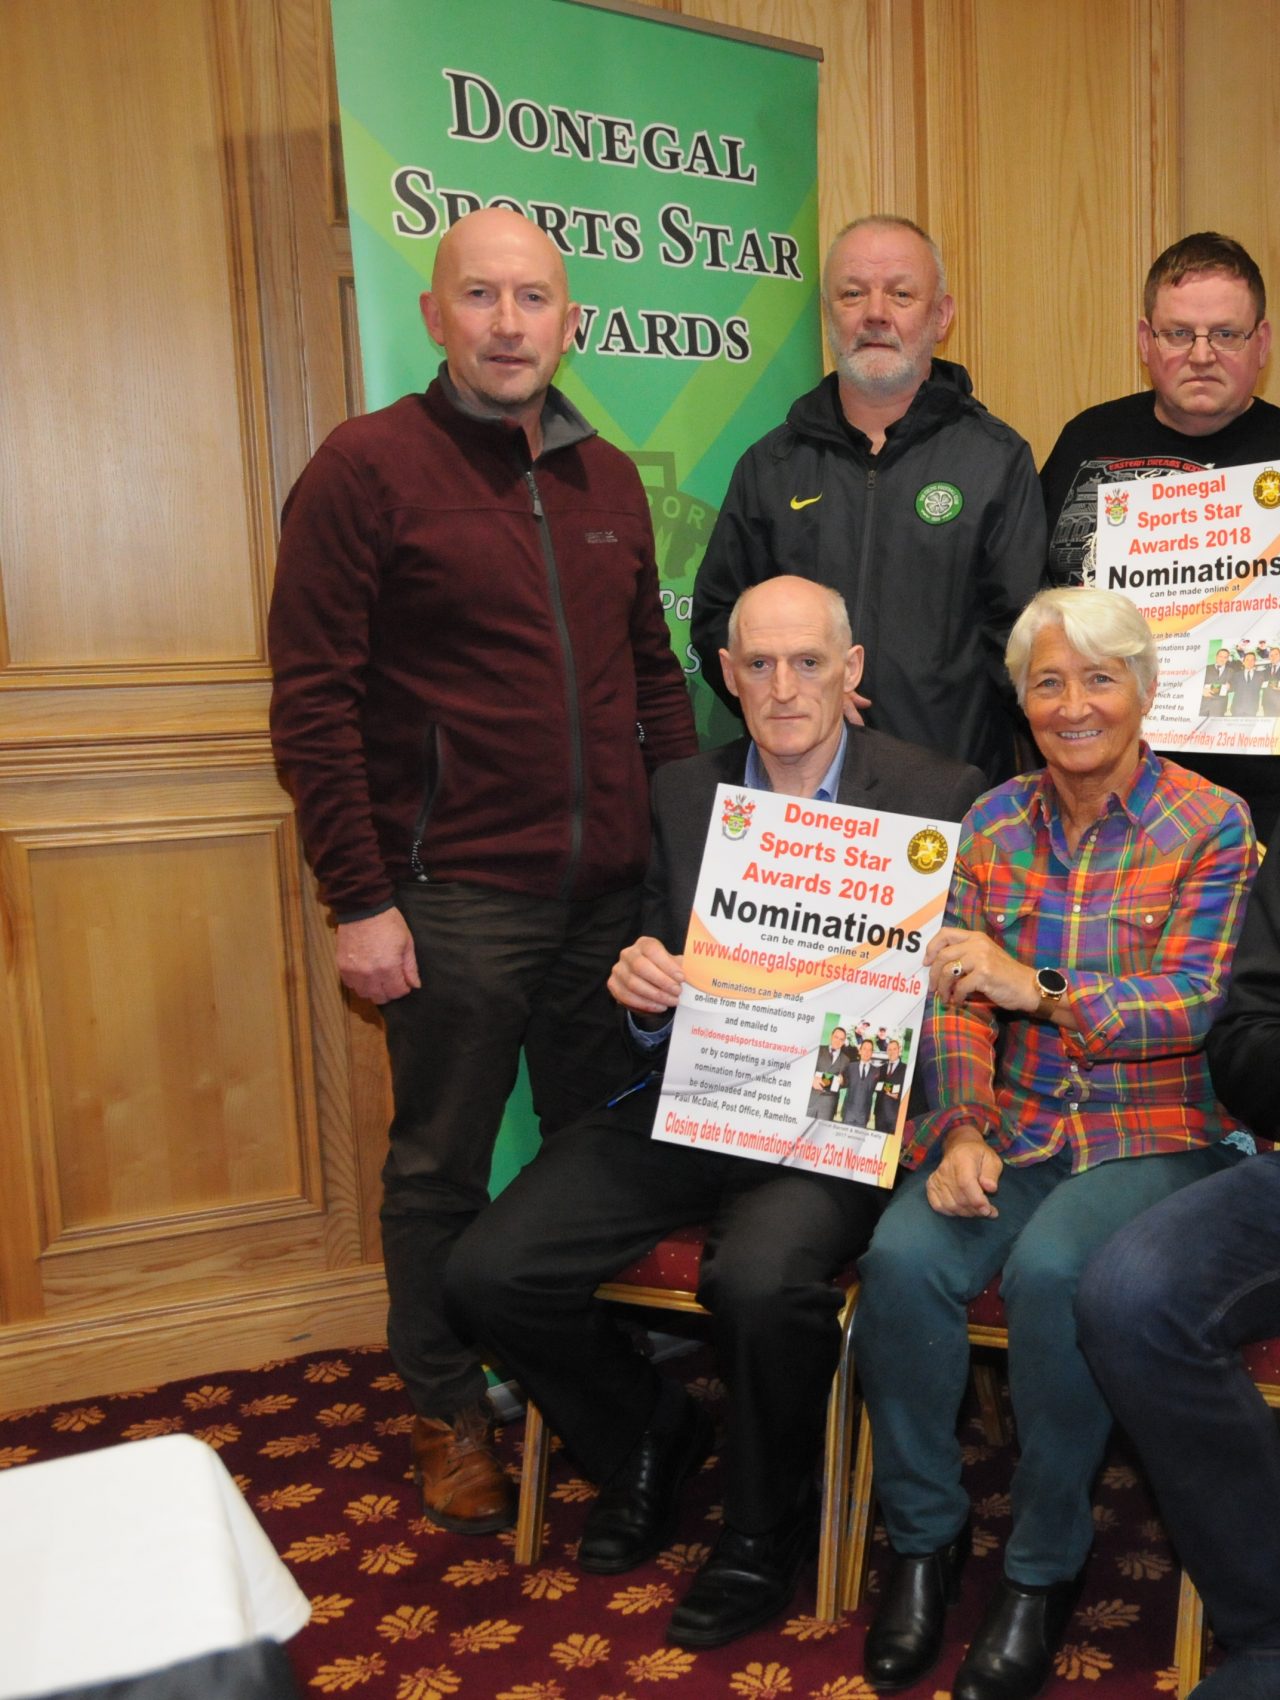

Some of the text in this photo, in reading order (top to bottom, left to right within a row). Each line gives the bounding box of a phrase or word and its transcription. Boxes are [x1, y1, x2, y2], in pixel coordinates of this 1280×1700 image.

[1151, 474, 1226, 499] Donegal
[1137, 502, 1242, 531] Sports Star
[1128, 526, 1252, 555] Awards 2018
[1149, 583, 1240, 598] can be made online at
[1238, 731, 1279, 748] November
[783, 802, 880, 839] Donegal
[758, 831, 892, 873] Sports Star
[741, 861, 896, 906] Awards 2018
[709, 887, 923, 955] Nominations
[759, 931, 870, 960] can be made online at
[691, 938, 922, 994] www.donegalsportsstarawards.ie
[711, 978, 804, 1003] Nominations can be made
[719, 997, 736, 1008] from
[737, 1000, 750, 1010] the
[751, 1004, 795, 1019] nominations
[796, 1012, 815, 1024] page
[724, 1016, 778, 1033] and emailed to
[700, 1046, 708, 1054] or
[709, 1046, 718, 1058] by
[719, 1050, 759, 1066] completing
[766, 1059, 791, 1071] simple
[694, 1063, 733, 1077] nomination
[754, 1074, 777, 1085] which
[777, 1078, 791, 1088] can
[688, 1077, 791, 1105] be downloaded and posted to
[721, 1100, 737, 1112] Post
[664, 1111, 699, 1143] Closing
[699, 1118, 722, 1143] date
[721, 1122, 736, 1145] for
[822, 1142, 844, 1167] 23rd
[843, 1147, 887, 1177] November
